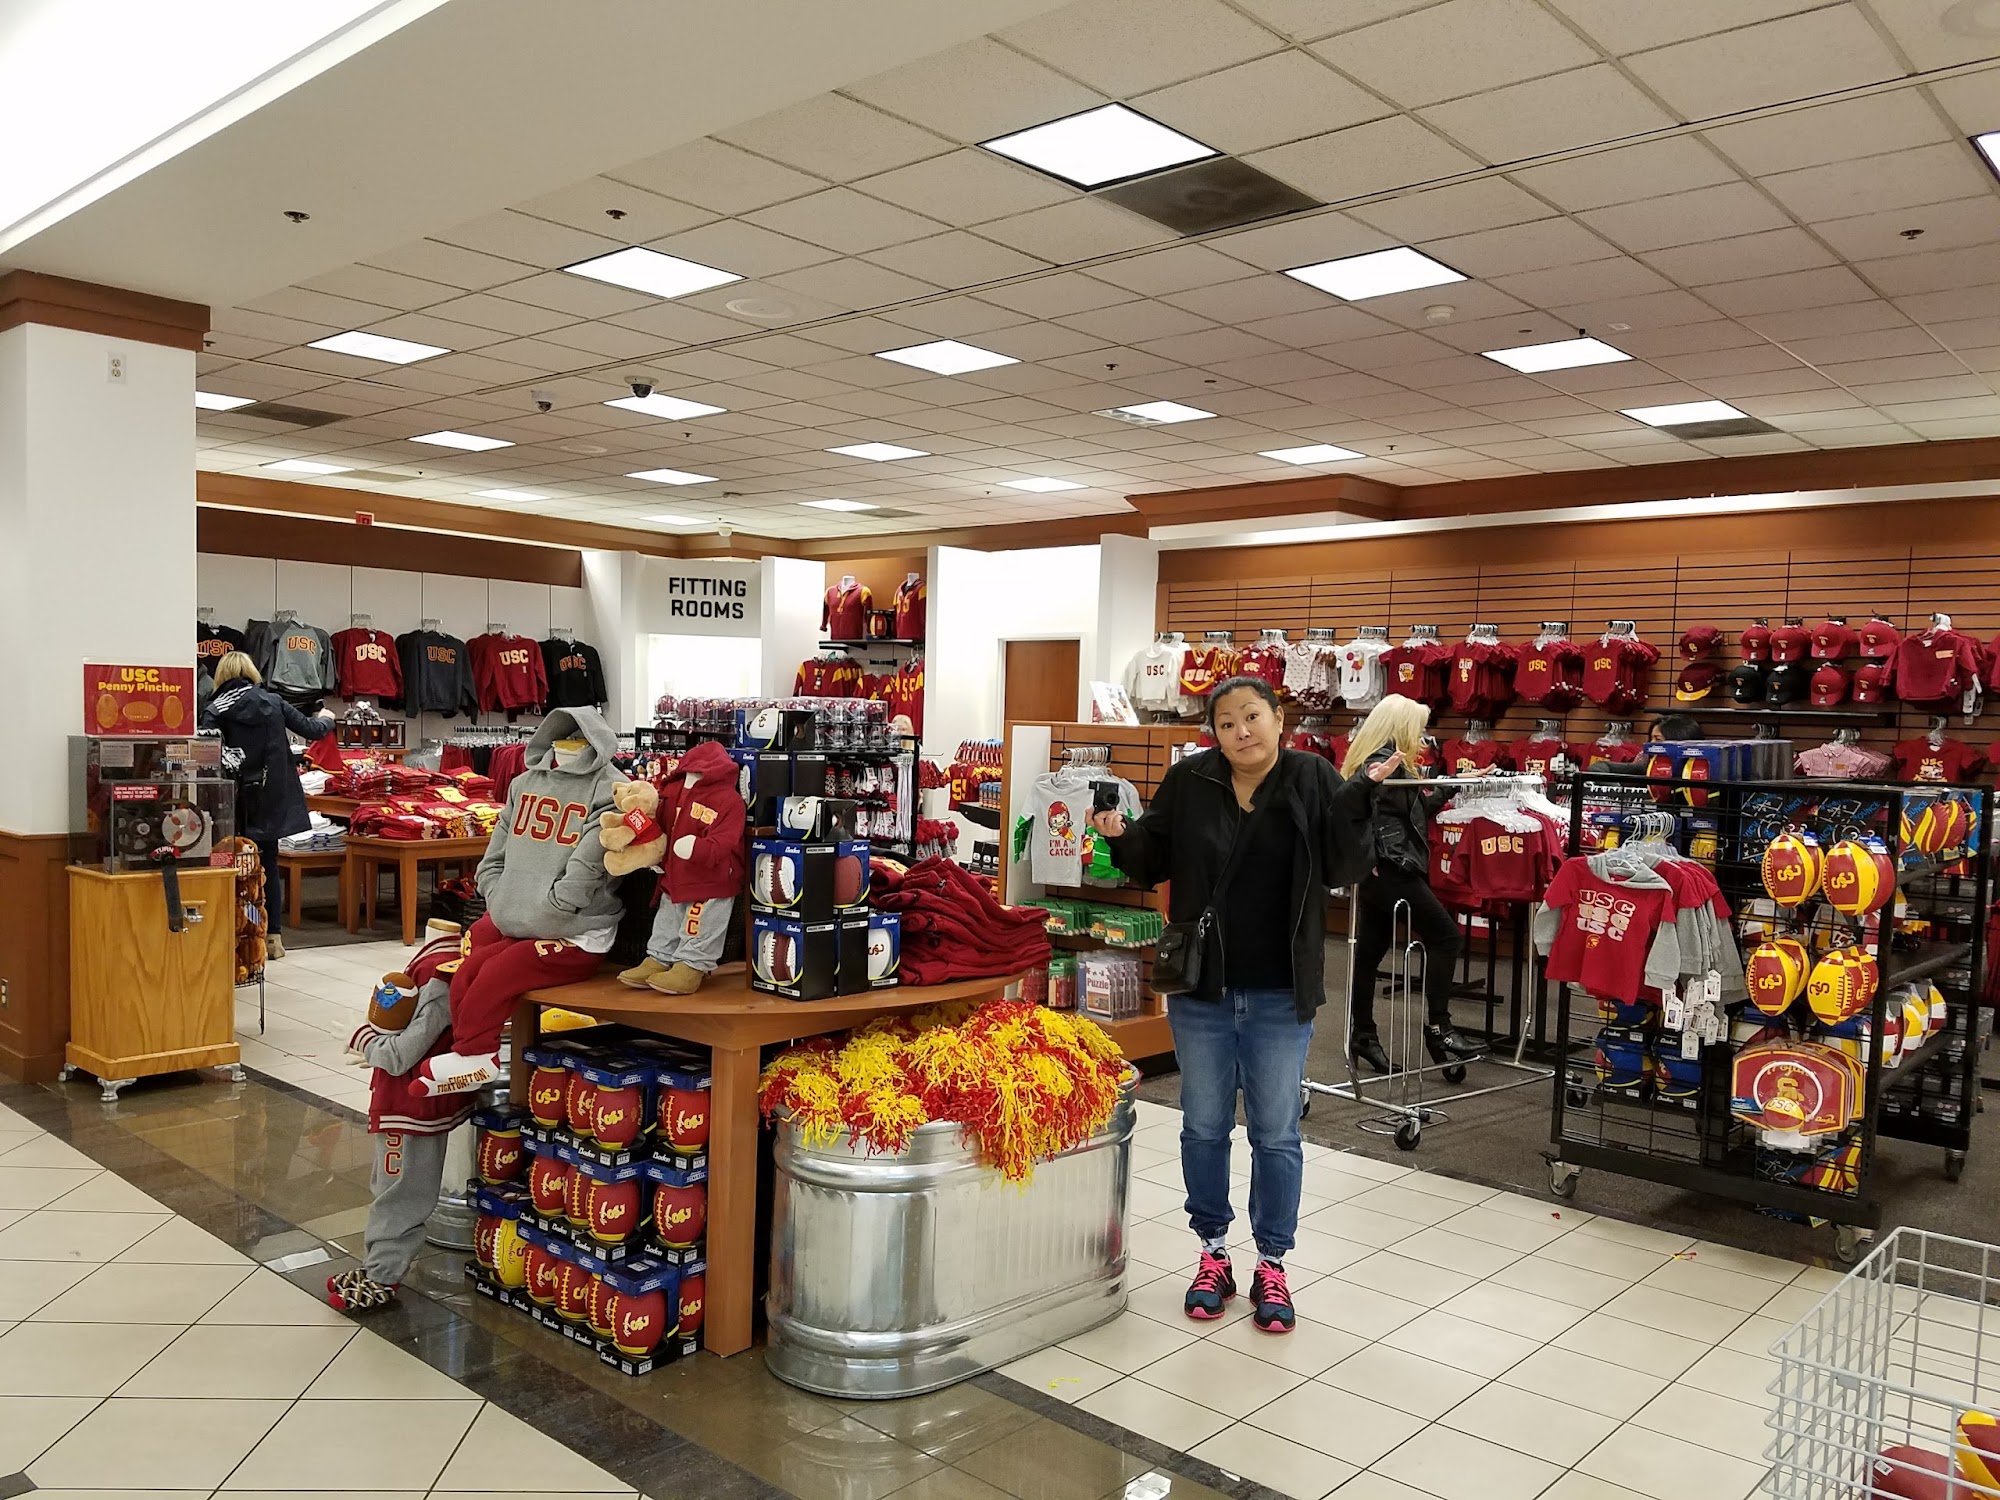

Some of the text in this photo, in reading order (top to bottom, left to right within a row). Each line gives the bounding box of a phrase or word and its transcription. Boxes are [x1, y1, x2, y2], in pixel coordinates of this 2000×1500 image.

[668, 576, 747, 597] FITTING
[671, 599, 744, 619] ROOMS
[287, 636, 316, 655] USC
[355, 643, 387, 663] USC
[427, 646, 456, 664] USC
[498, 649, 529, 666] USC
[1146, 664, 1165, 676] USC
[1243, 662, 1260, 672] USC
[1528, 659, 1547, 672] USC
[1594, 658, 1612, 671] USC
[121, 668, 159, 682] USC
[1183, 668, 1212, 682] USC
[98, 681, 181, 693] Penny Pincher
[1921, 758, 1943, 767] USC
[513, 792, 588, 848] USC
[690, 802, 718, 825] US
[155, 846, 174, 854] TURN
[1050, 840, 1068, 848] I'M A
[1480, 836, 1524, 855] USC
[1050, 848, 1076, 856] CATCH!
[1579, 889, 1636, 918] USC
[1576, 917, 1624, 942] USC
[1087, 978, 1109, 990] Puzzle
[448, 1068, 490, 1083] FIGHT ON!
